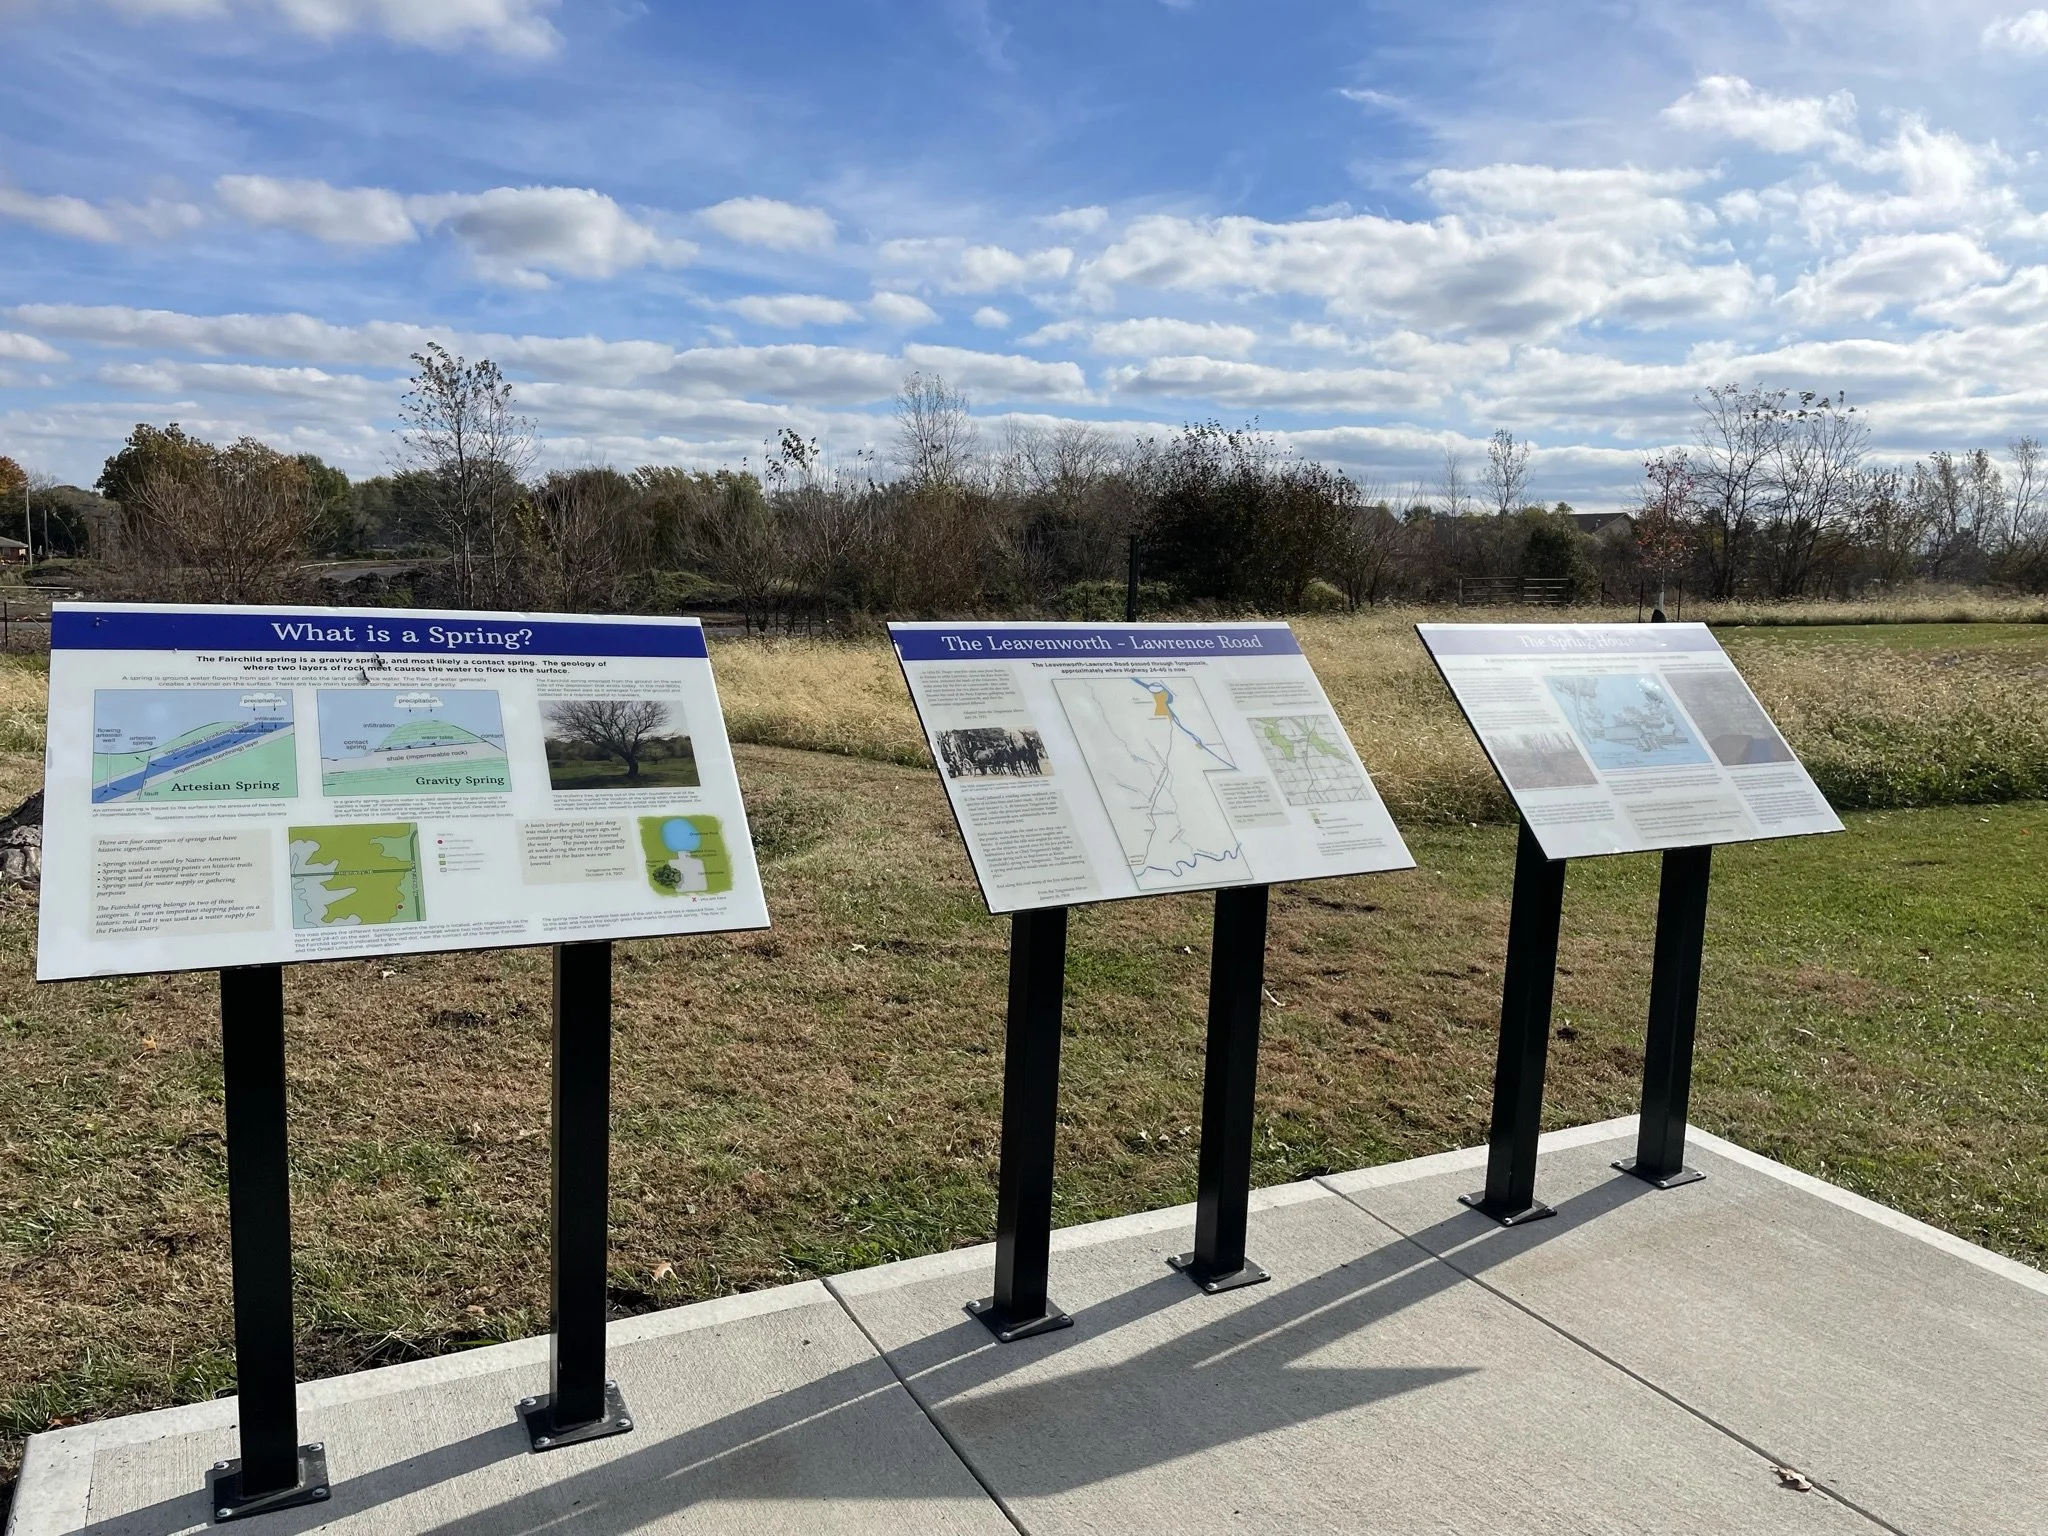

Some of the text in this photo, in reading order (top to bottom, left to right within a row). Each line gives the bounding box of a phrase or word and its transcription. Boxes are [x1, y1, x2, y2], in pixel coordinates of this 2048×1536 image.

[271, 622, 532, 650] What is a Spring?
[941, 636, 983, 651] The
[987, 636, 1112, 651] Leavenworth
[1129, 636, 1215, 650] Lawrence
[1216, 634, 1263, 650] Road
[171, 780, 280, 792] Artesian Spring
[416, 776, 504, 786] Gravity Spring
